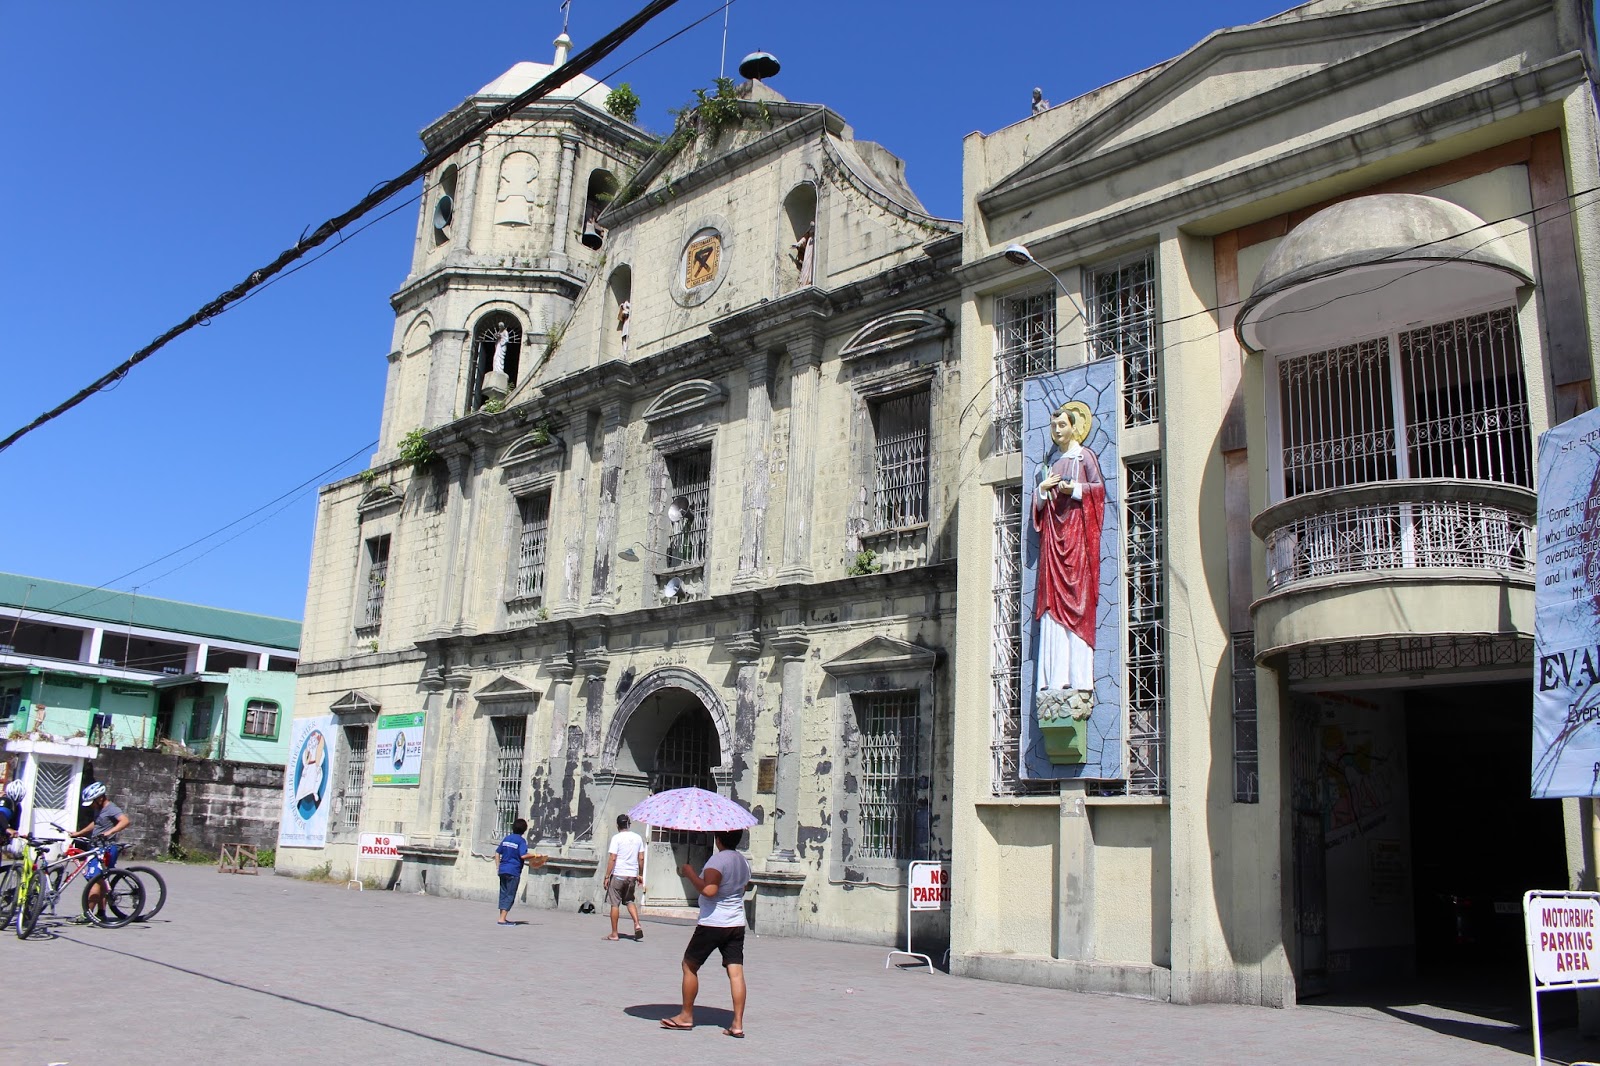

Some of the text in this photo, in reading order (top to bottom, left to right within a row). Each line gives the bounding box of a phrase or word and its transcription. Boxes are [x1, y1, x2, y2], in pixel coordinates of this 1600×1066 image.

[1580, 427, 1600, 446] STE
[1577, 501, 1585, 512] to
[1545, 529, 1561, 545] who
[1545, 570, 1560, 586] and
[1572, 562, 1584, 579] will
[1572, 585, 1586, 600] Mt.
[1540, 645, 1600, 692] EVA
[375, 837, 391, 846] NO
[931, 870, 948, 885] NO
[913, 887, 951, 902] PARKI
[1542, 907, 1594, 928] MOTORBIKE
[1540, 931, 1593, 951] PARKING
[1556, 952, 1590, 972] AREA
